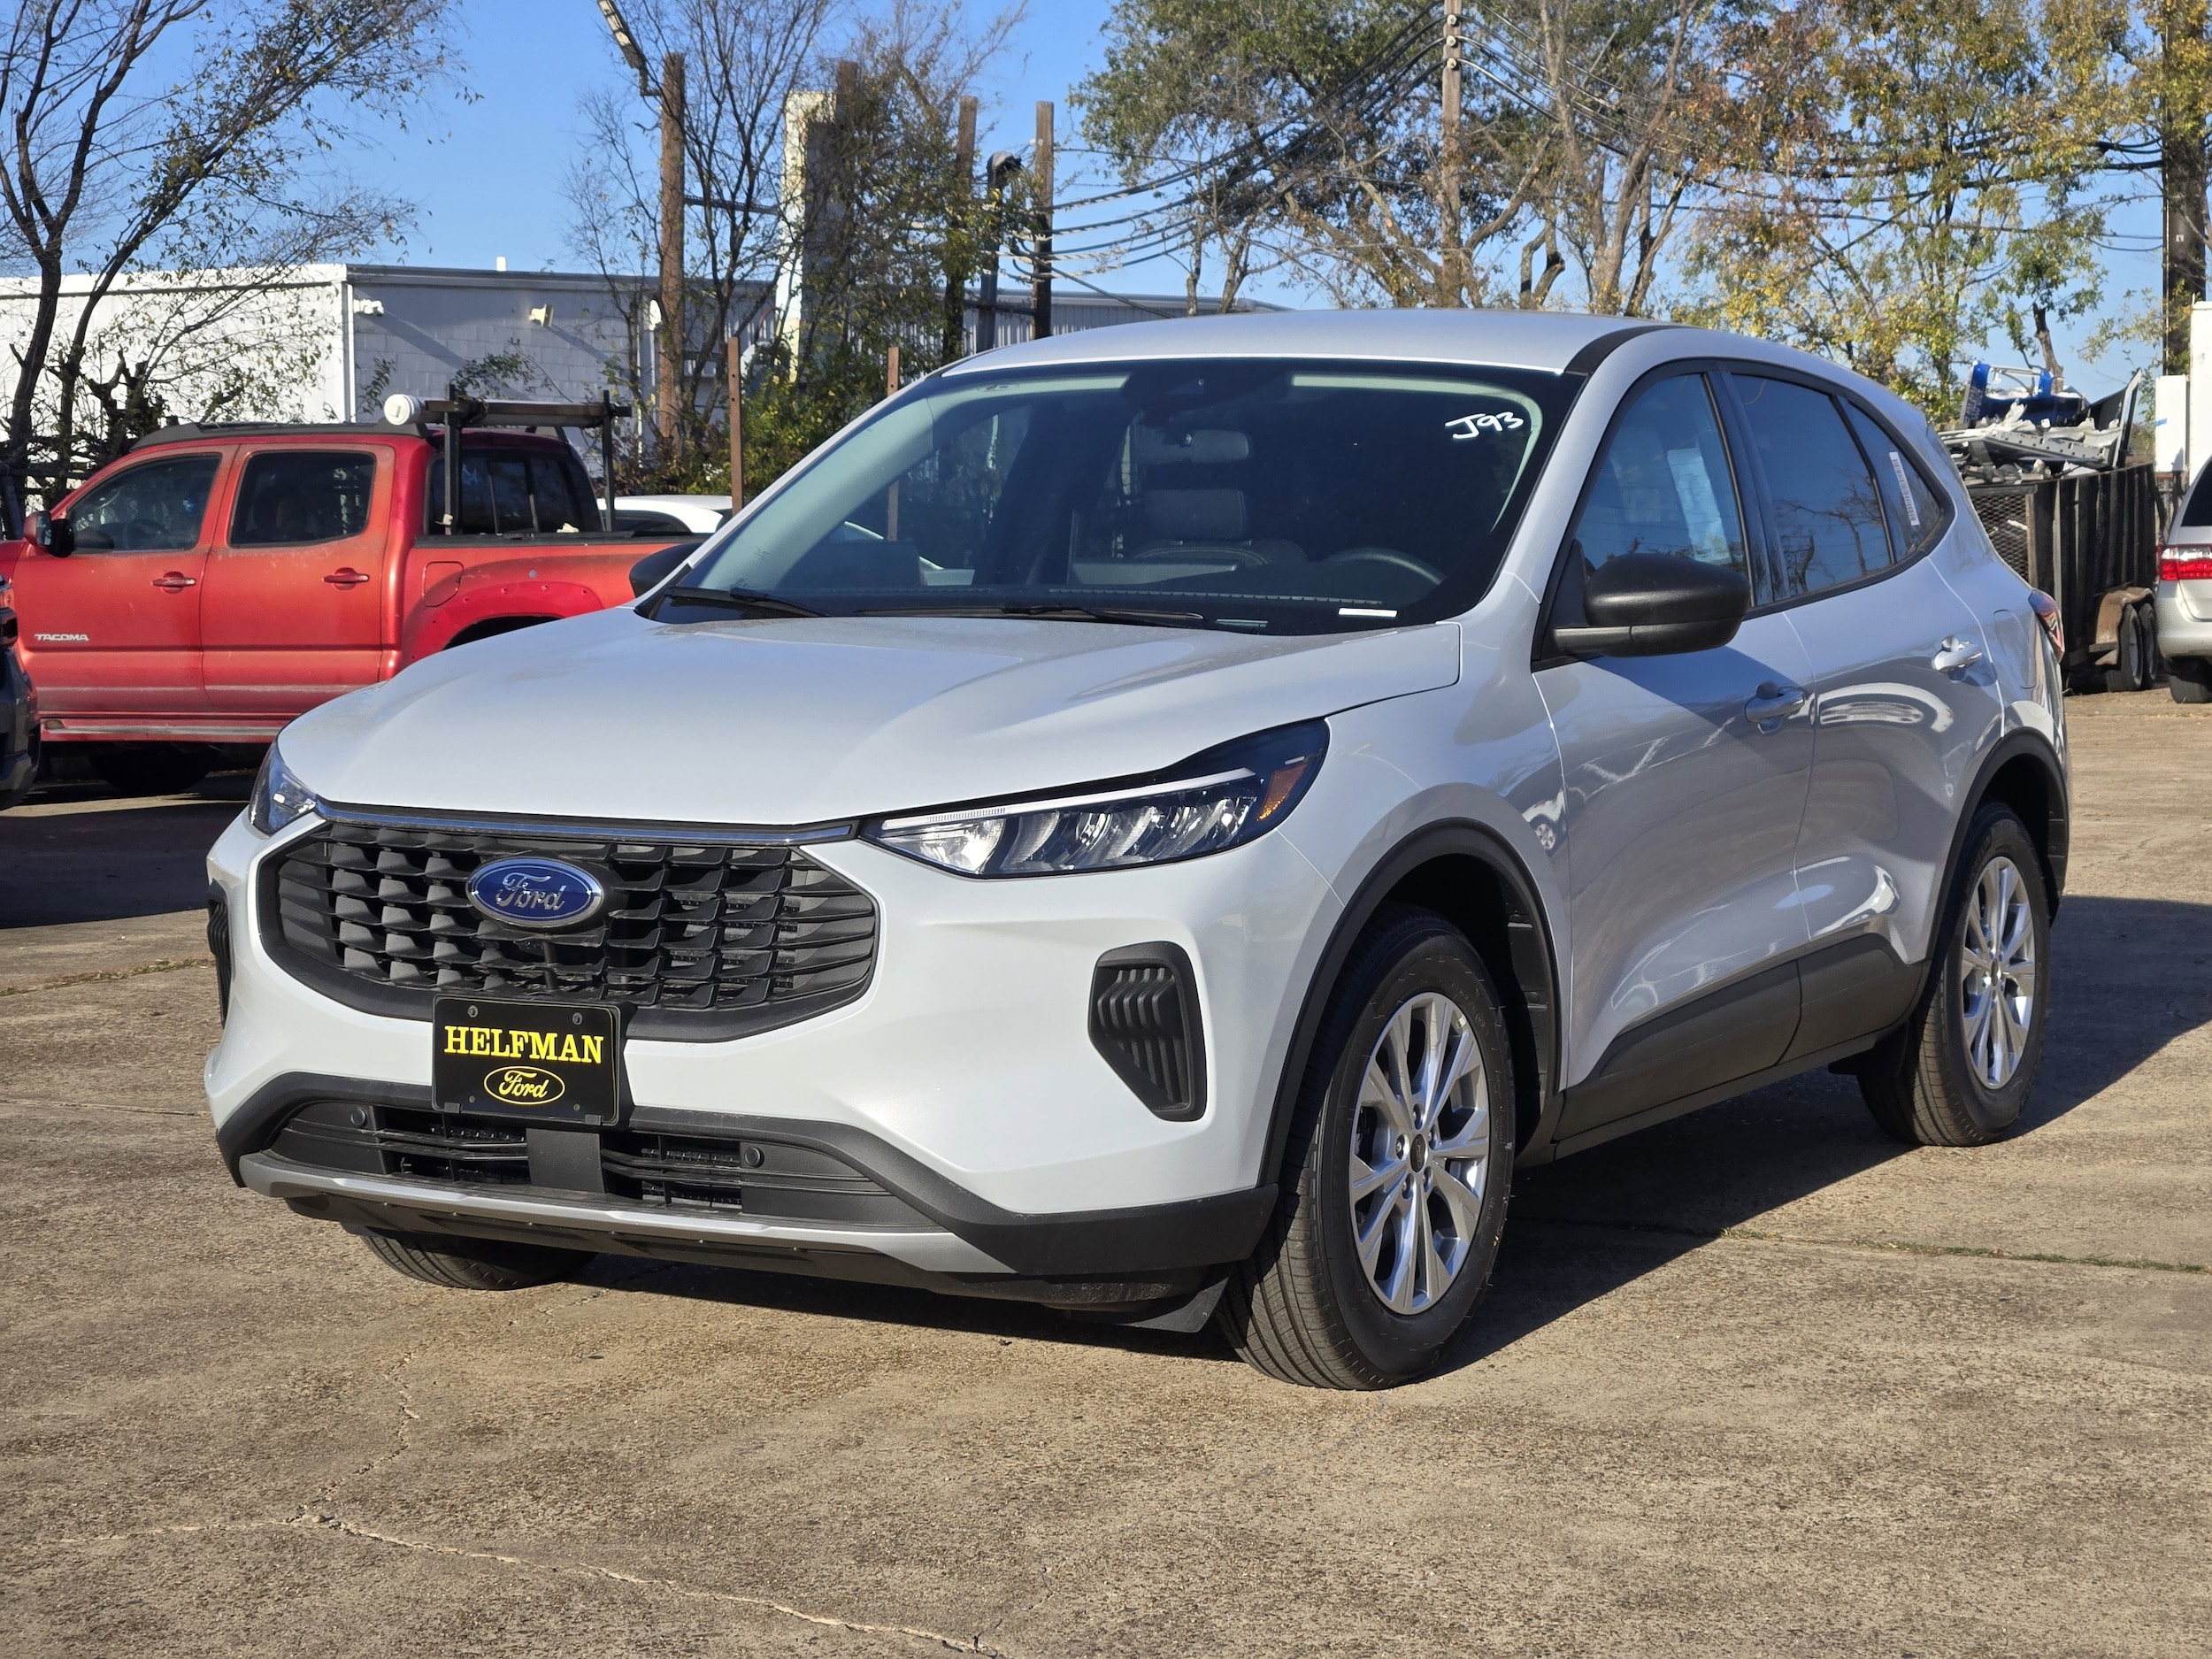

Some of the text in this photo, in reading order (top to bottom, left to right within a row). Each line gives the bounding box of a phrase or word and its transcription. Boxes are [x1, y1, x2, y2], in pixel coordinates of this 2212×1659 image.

[1444, 411, 1524, 439] J93
[495, 872, 566, 911] Ford
[444, 1025, 604, 1064] HELFMAN
[498, 1069, 549, 1099] Ford
